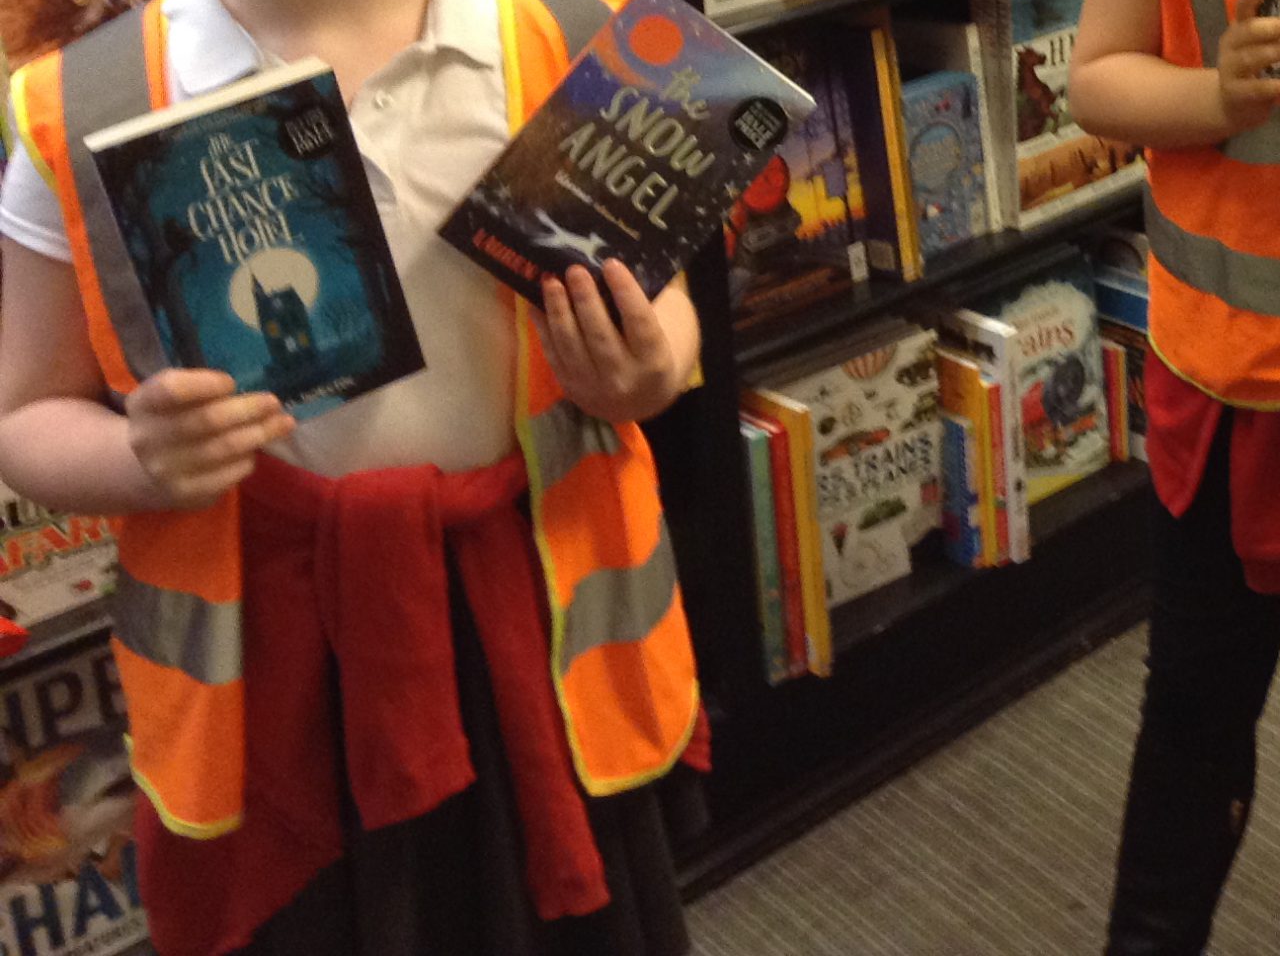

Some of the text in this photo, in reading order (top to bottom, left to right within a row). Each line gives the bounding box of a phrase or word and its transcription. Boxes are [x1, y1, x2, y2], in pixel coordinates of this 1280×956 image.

[199, 138, 262, 197] LAST
[599, 85, 717, 178] SNOW
[186, 172, 300, 243] CHANCE
[557, 120, 680, 231] ANGEL
